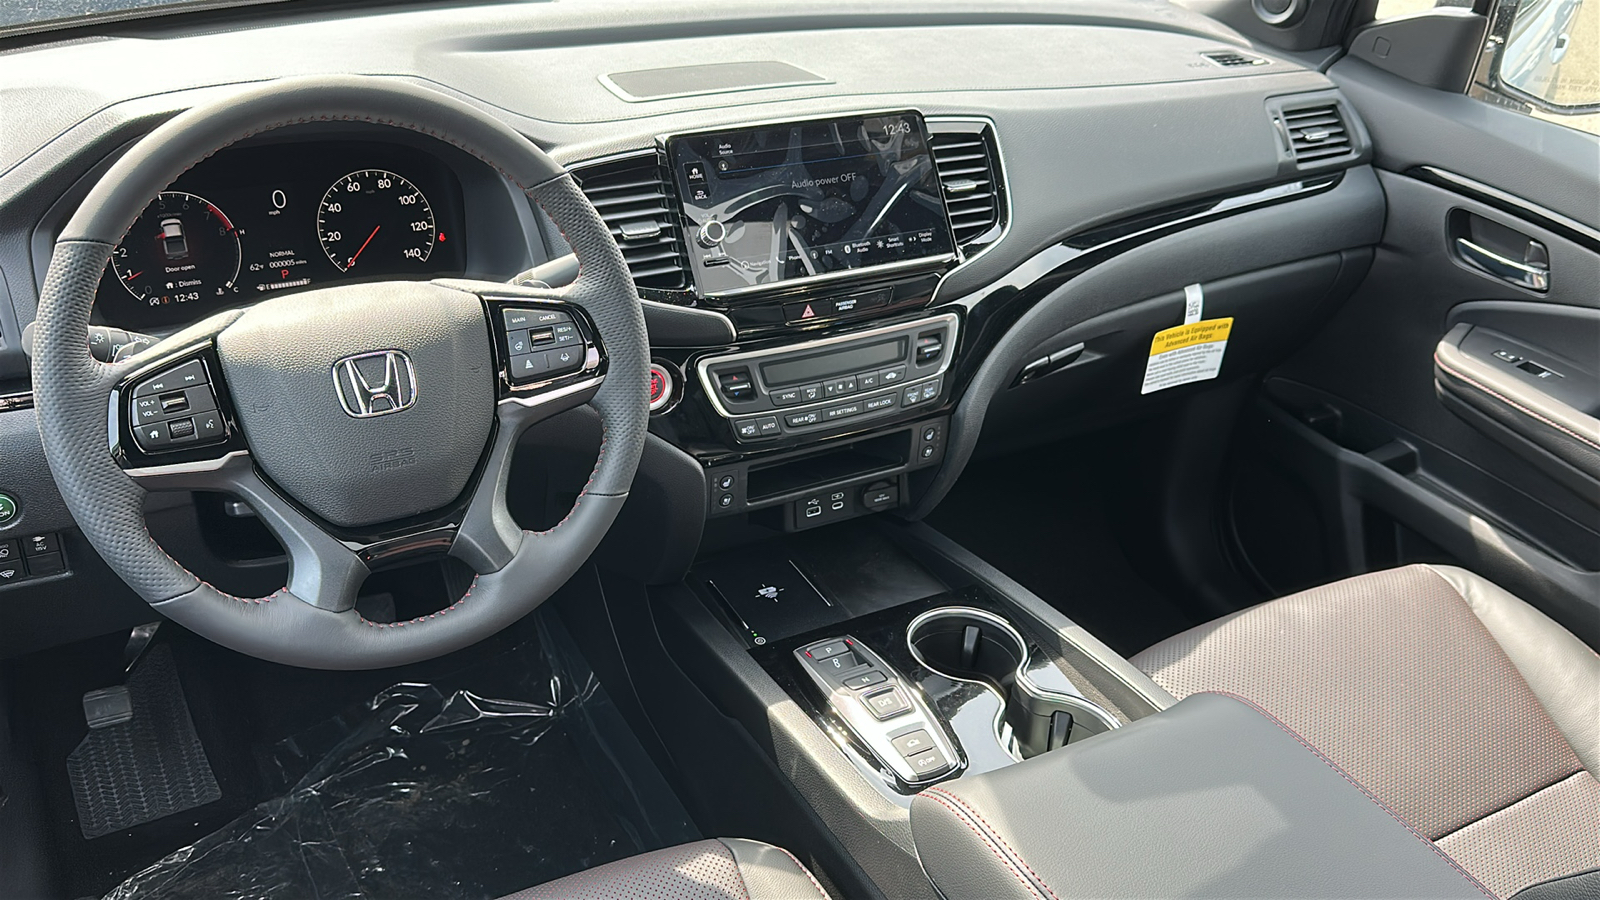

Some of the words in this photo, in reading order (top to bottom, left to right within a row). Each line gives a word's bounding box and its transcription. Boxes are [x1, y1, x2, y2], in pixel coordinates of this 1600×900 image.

[882, 122, 911, 136] 12:43
[377, 178, 392, 189] 80
[791, 178, 814, 189] Audio
[815, 176, 839, 188] power
[840, 172, 857, 182] OFF
[346, 182, 360, 192] 60
[272, 189, 287, 209] 0
[398, 194, 416, 205] 100
[328, 202, 342, 213] 40
[204, 212, 210, 220] 7
[220, 227, 226, 236] 8
[410, 221, 428, 232] 120
[327, 232, 342, 242] 20
[120, 248, 128, 258] 2
[269, 250, 295, 258] NORMAL
[403, 248, 421, 259] 140
[165, 266, 180, 274] Door
[181, 264, 196, 272] open
[268, 259, 296, 269] 000005
[127, 269, 133, 277] 1
[281, 269, 290, 279] P
[178, 279, 202, 288] Dismiss
[174, 292, 200, 302] 12:43
[538, 314, 556, 322] CANCEL
[1166, 330, 1184, 340] Vehicle
[1190, 324, 1216, 334] Equipped
[1165, 338, 1190, 348] Advanced
[836, 406, 858, 416] SETTINGS
